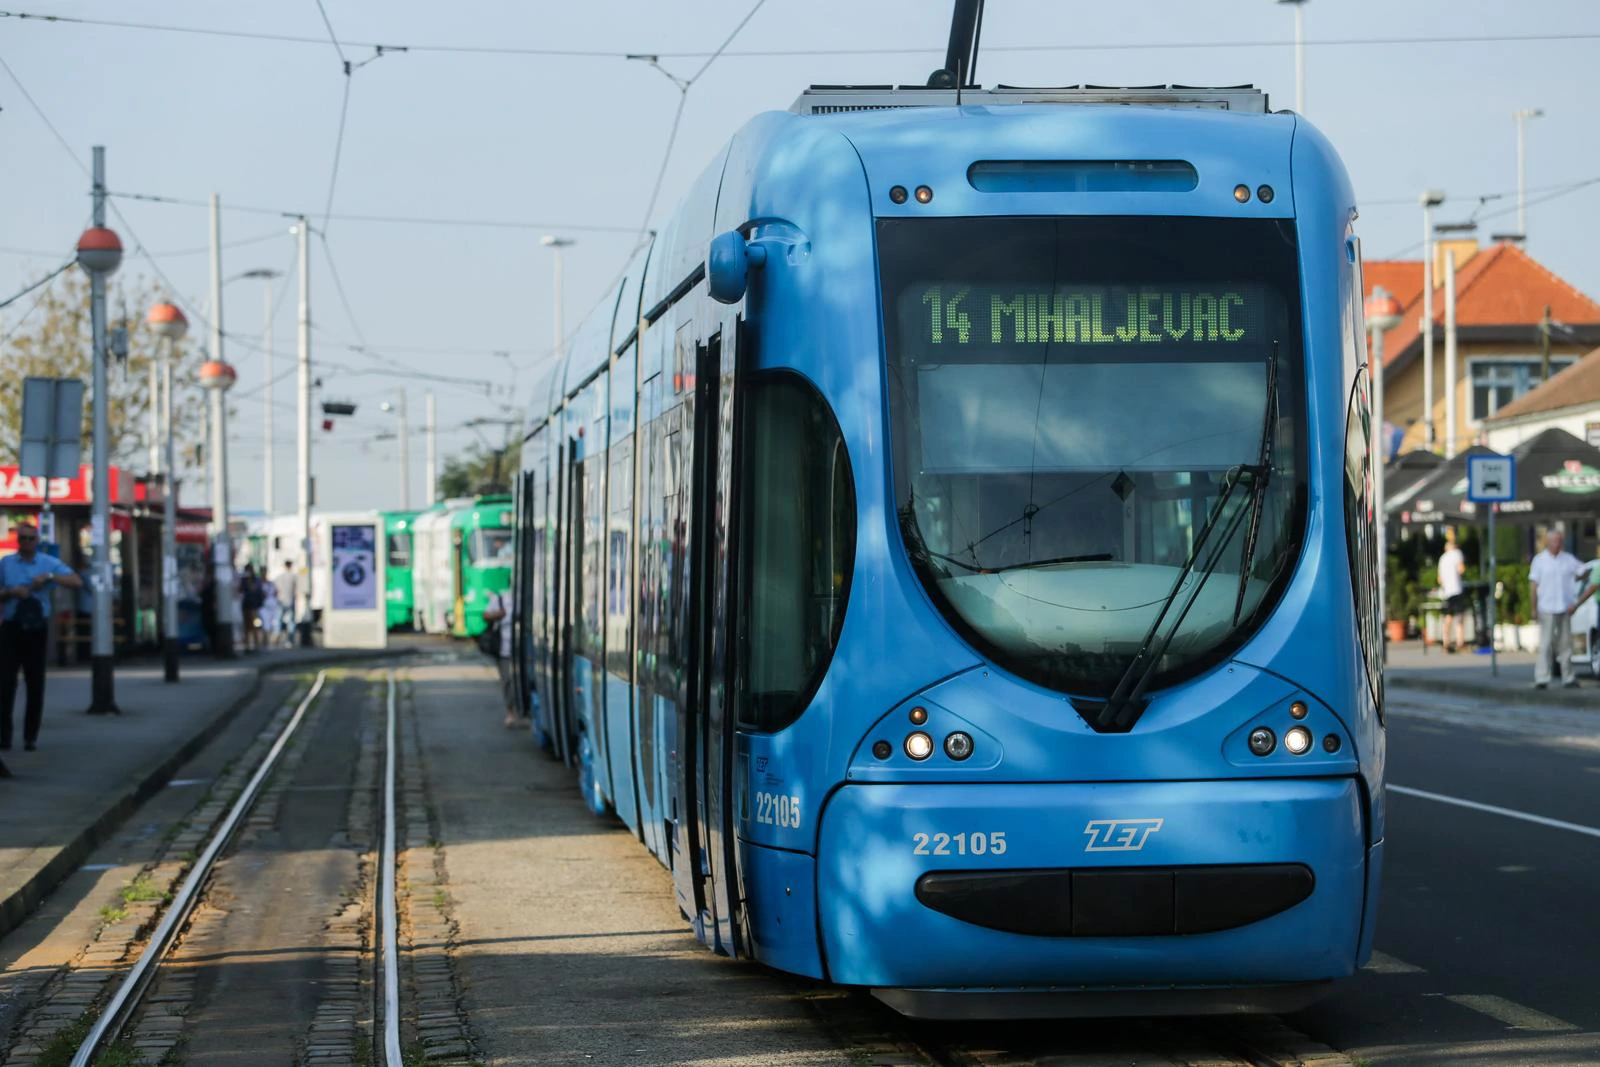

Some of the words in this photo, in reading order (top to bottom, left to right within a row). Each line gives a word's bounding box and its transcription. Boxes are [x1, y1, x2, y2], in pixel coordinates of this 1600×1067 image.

[923, 287, 971, 343] 14
[991, 293, 1245, 342] MIHALJEVAC
[0, 471, 71, 499] AB
[756, 791, 800, 829] 22105
[913, 832, 1007, 855] 22105
[1084, 818, 1164, 852] ZET
